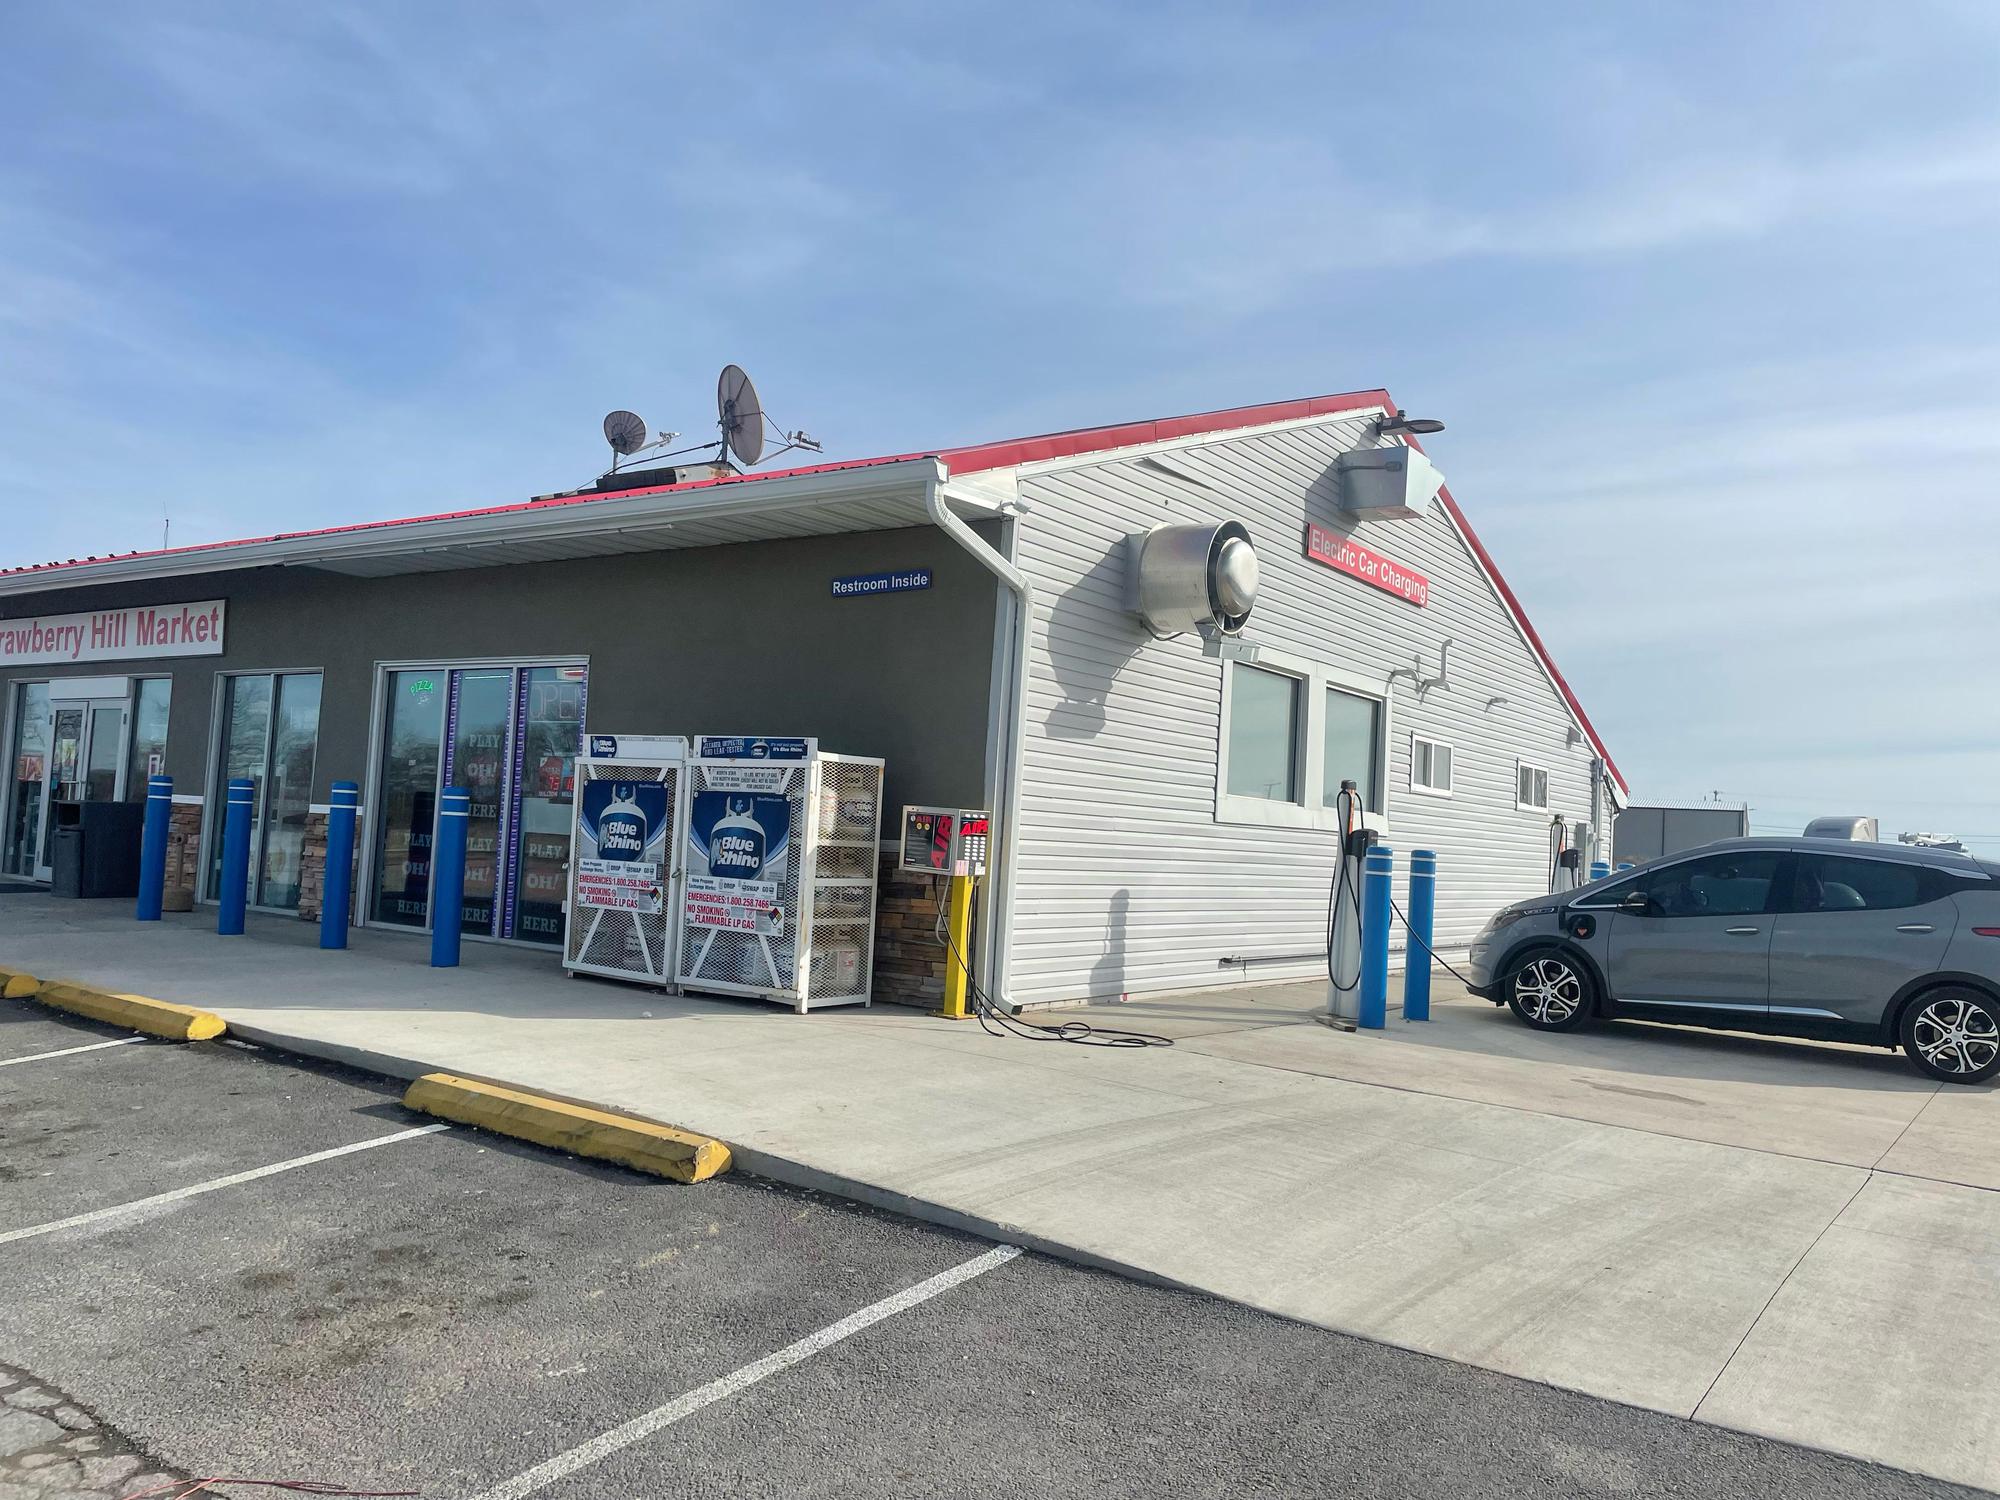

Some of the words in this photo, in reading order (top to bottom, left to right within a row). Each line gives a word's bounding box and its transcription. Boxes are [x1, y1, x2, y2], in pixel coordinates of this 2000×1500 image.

[1311, 529, 1355, 567] Electric
[1359, 552, 1378, 577] Car
[1381, 562, 1426, 603] Charging
[833, 579, 887, 594] Restroom
[892, 574, 928, 588] Inside
[90, 612, 128, 649] Hill
[136, 606, 219, 646] Market
[410, 679, 433, 696] PIZZA
[469, 734, 501, 748] PLAY
[467, 762, 498, 778] OH!
[609, 822, 637, 836] Blue
[960, 819, 989, 836] AIR
[404, 833, 432, 847] PLAY
[605, 837, 642, 851] Rhino
[722, 836, 755, 851] Blue
[529, 843, 562, 859] PLAY
[717, 851, 759, 869] Rhino
[402, 861, 429, 876] OH!
[526, 873, 560, 890] OH!
[579, 886, 586, 894] NO
[587, 887, 612, 897] SMOKING
[397, 900, 427, 915] HERE
[586, 896, 617, 907] FLAMMABLE
[619, 899, 626, 907] LP
[627, 900, 638, 908] GAS
[687, 904, 695, 913] NO
[697, 905, 725, 916] SMOKING
[523, 916, 558, 933] HERE
[695, 915, 731, 927] FLAMMABLE
[733, 919, 740, 928] LP
[742, 920, 755, 929] GAS
